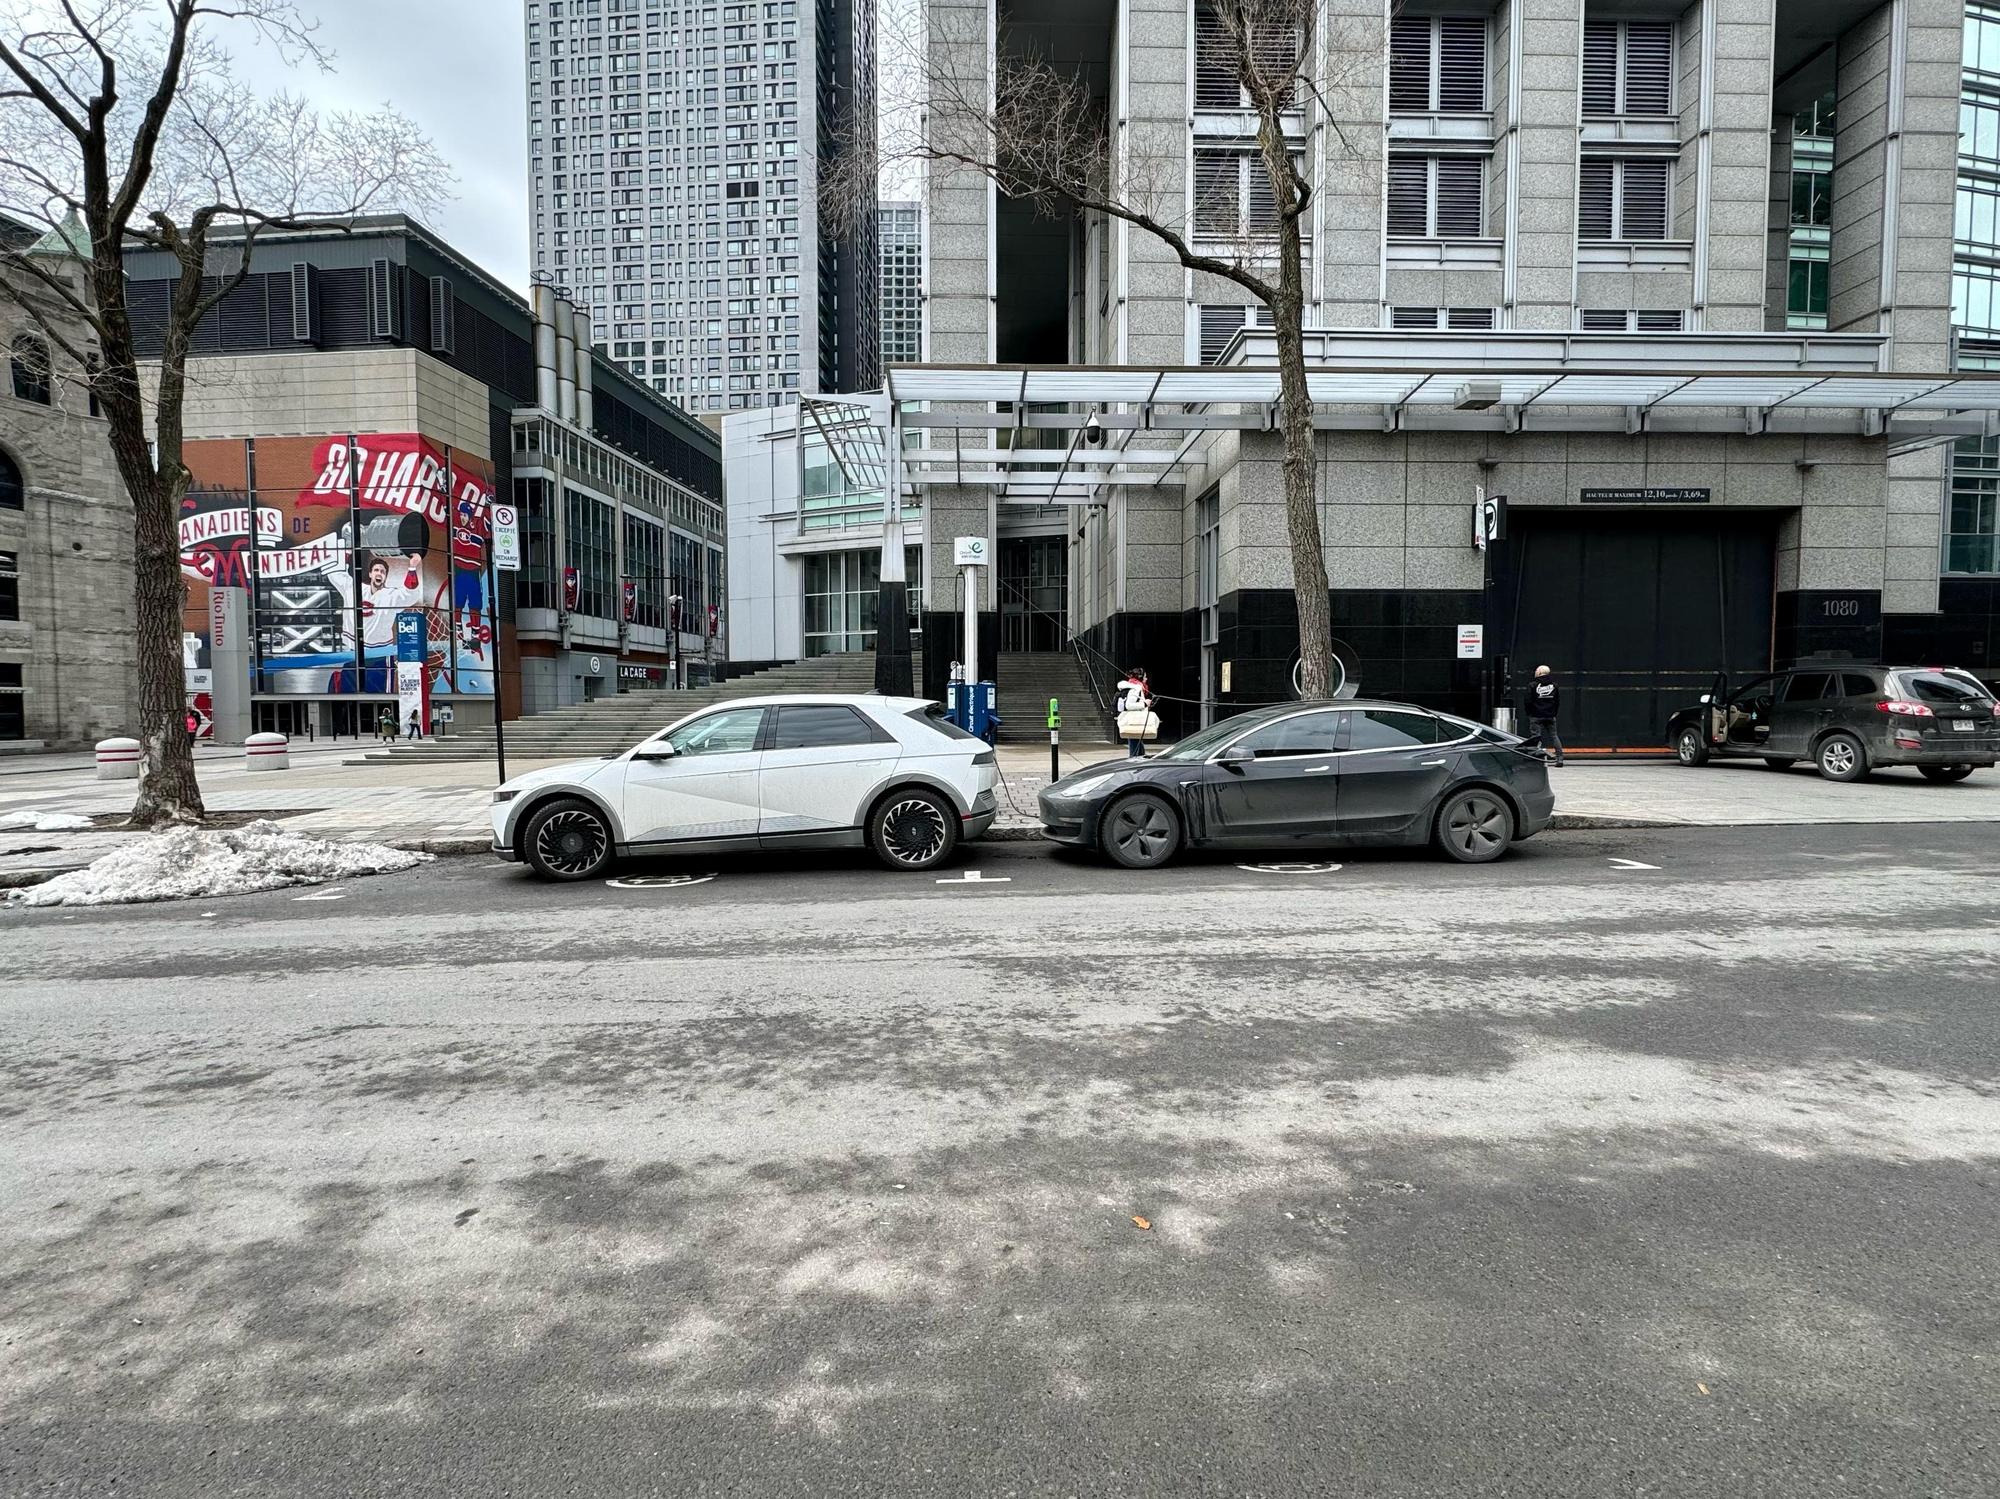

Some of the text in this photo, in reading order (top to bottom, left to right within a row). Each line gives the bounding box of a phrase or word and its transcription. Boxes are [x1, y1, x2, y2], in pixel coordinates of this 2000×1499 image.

[180, 500, 311, 546] ANADIENS DE
[1823, 600, 1859, 616] 1080
[398, 621, 418, 634] Bell
[620, 667, 629, 678] LA
[629, 667, 647, 679] CAGE
